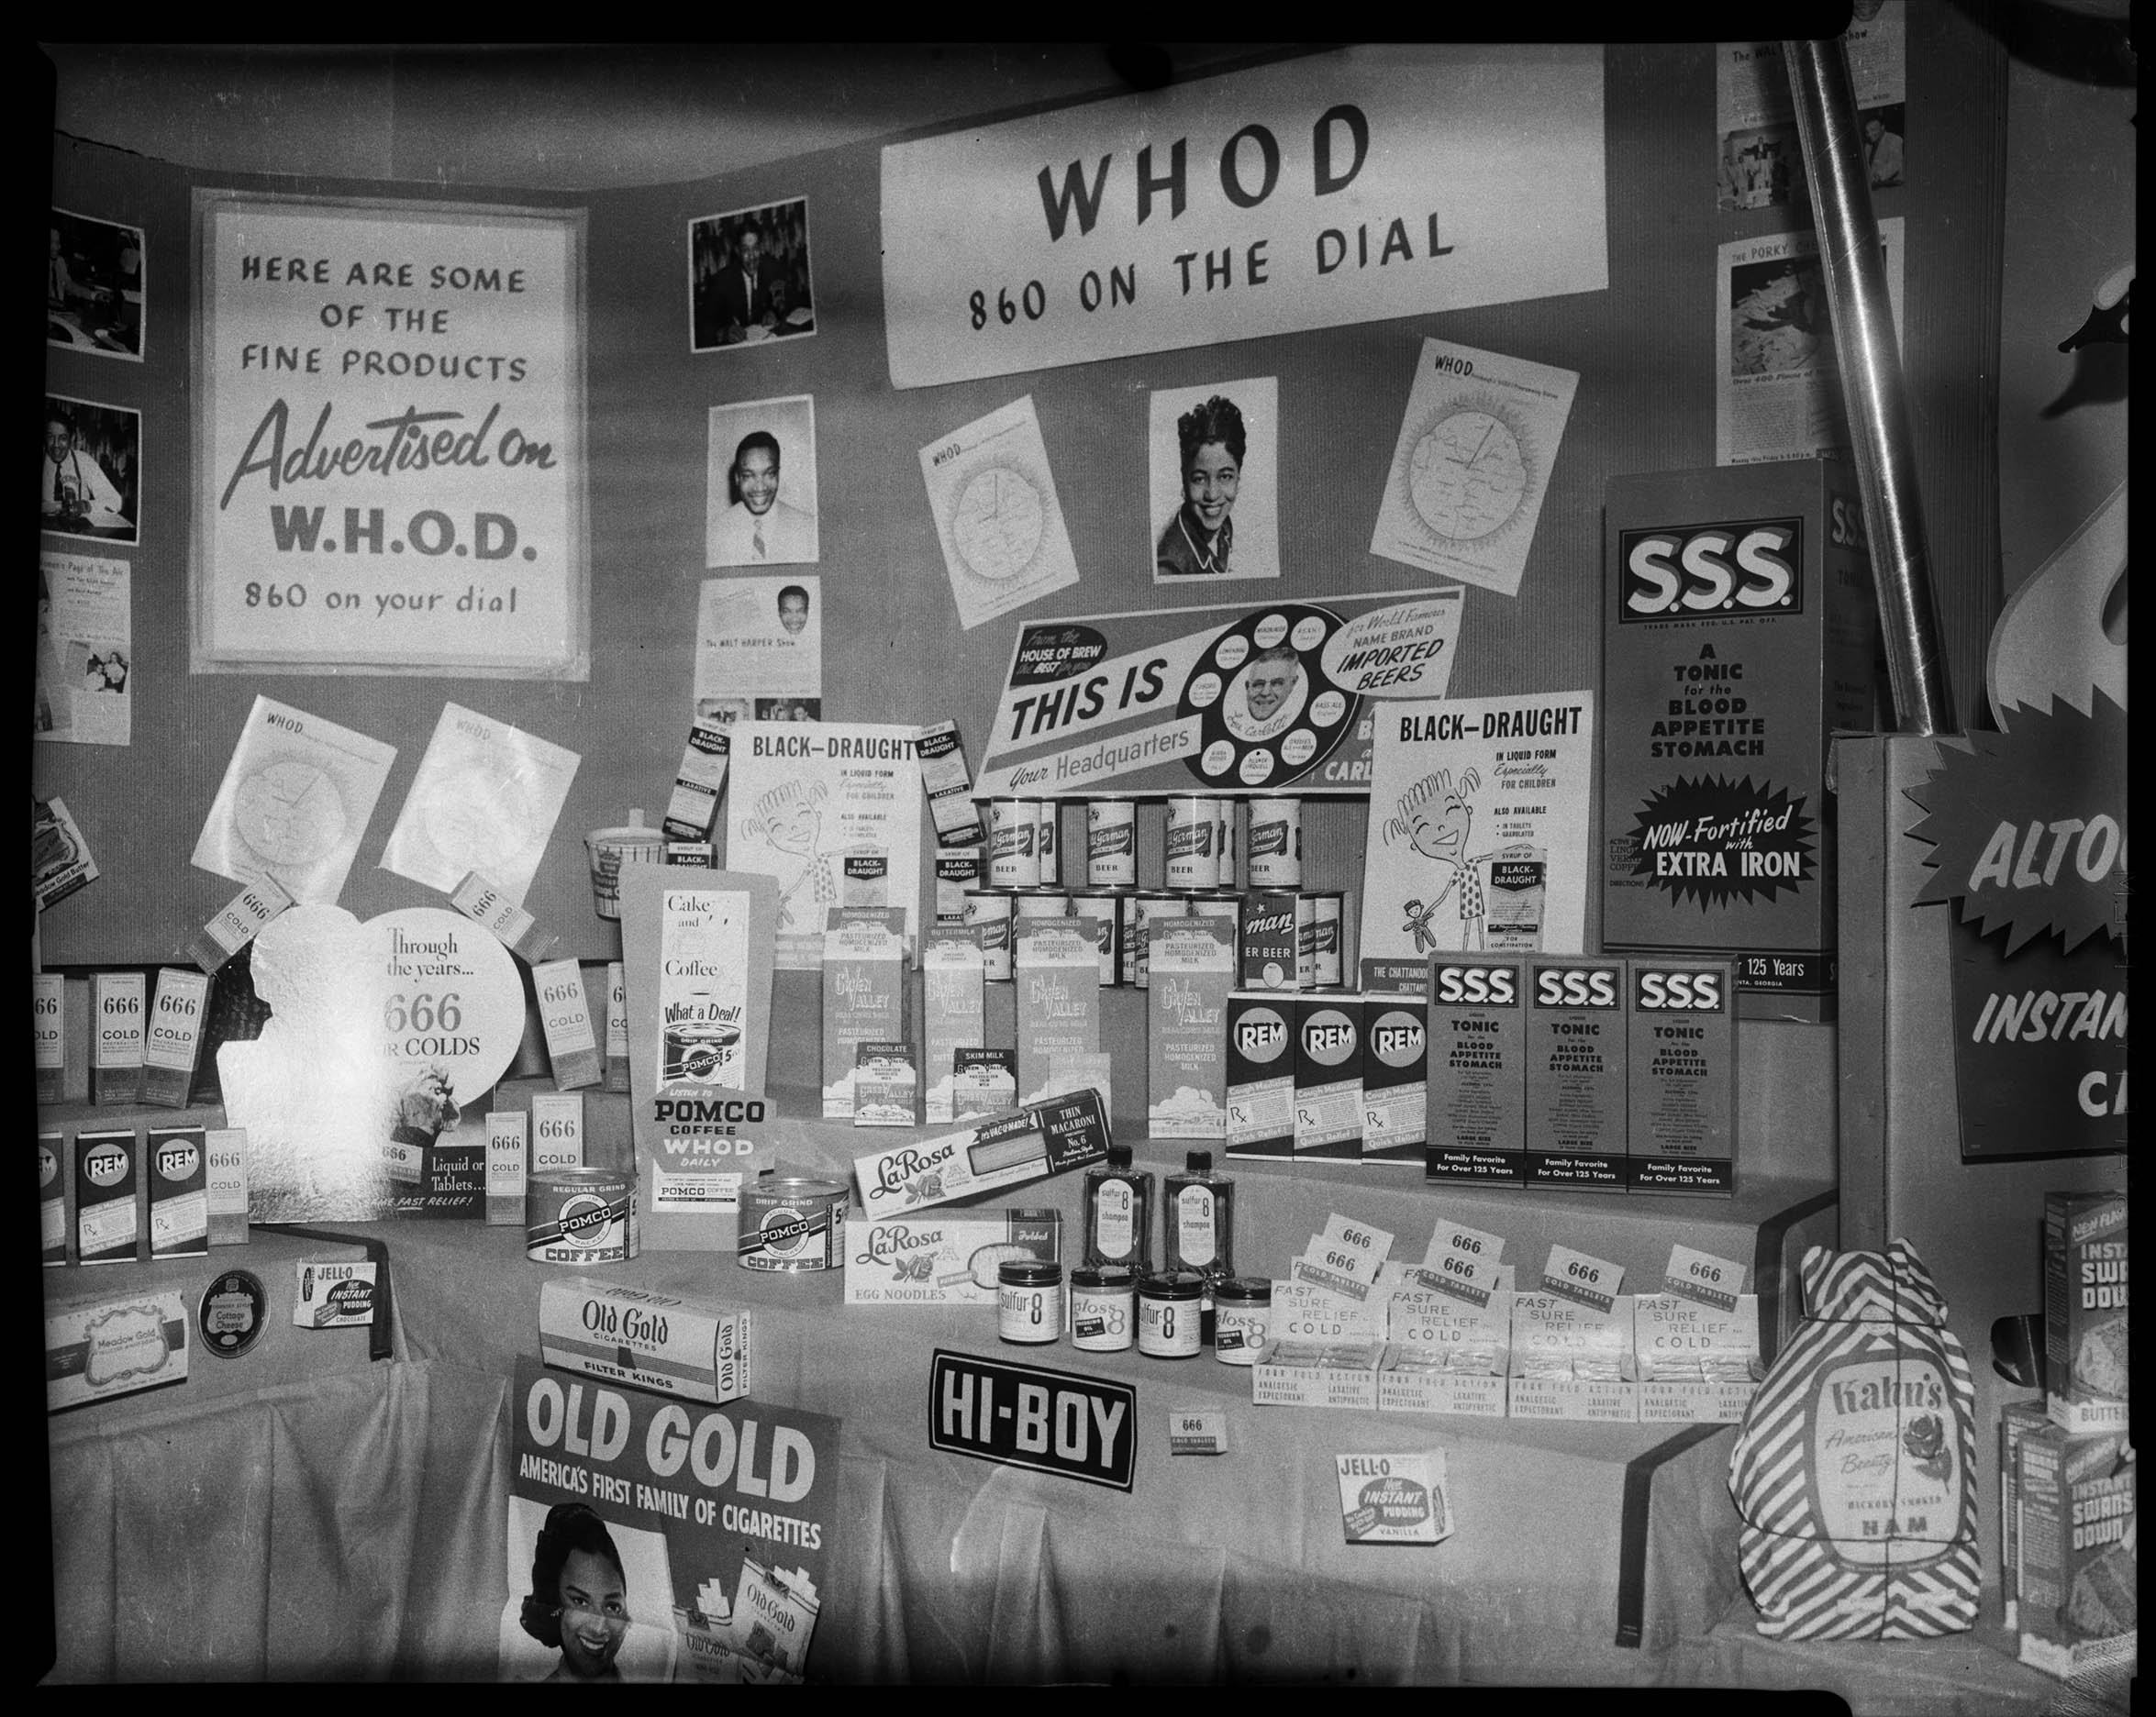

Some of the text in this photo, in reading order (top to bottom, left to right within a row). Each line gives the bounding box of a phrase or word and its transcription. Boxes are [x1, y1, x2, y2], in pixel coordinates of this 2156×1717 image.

[1038, 104, 1370, 242] WHOD
[242, 256, 525, 294] HERE ARE SOME
[969, 211, 1455, 330] 860 ON THE DIAL
[320, 304, 448, 334] OF THE
[242, 345, 527, 382] FINE PRODUCTS
[1434, 355, 1473, 377] WHOD
[220, 398, 500, 510] Advertised
[931, 443, 962, 466] WHOD
[271, 505, 538, 561] W.H.O.D.
[245, 582, 517, 618] 860 on your dial
[1353, 625, 1434, 649] NAME BRAND
[1020, 645, 1101, 662] HOUSE OF BREW
[1337, 638, 1444, 674] IMPORTED
[1699, 644, 1716, 659] A
[1033, 661, 1061, 674] BEST
[1356, 663, 1426, 691] BEERS
[1673, 663, 1742, 681] TONIC
[1684, 684, 1731, 695] for the
[1011, 659, 1168, 741] THIS IS
[1668, 698, 1747, 715] BLOOD
[266, 713, 304, 734] WHOD
[1650, 718, 1764, 737] APPETITE
[1496, 749, 1557, 761] IN LIQUID FORM
[1651, 739, 1764, 758] STOMACH
[1010, 767, 1048, 792] Your
[1056, 730, 1189, 780] Headquarters
[1494, 763, 1549, 778] Especially
[1502, 779, 1556, 790] FOR CHILDREN
[1514, 806, 1547, 814] AVAILABLE
[1096, 826, 1129, 847] German
[1725, 836, 1754, 850] with
[1968, 814, 2128, 892] ALTO
[1095, 864, 1118, 872] BEER
[1502, 865, 1534, 874] BLACK-
[1656, 851, 1800, 877] EXTRA IRON
[1495, 874, 1537, 885] DRAUGHT
[668, 895, 710, 912] Cake
[678, 916, 699, 927] and
[387, 927, 458, 960] Through
[387, 955, 412, 976] the
[665, 959, 717, 977] Coffee
[1748, 958, 1805, 977] 125 Years
[104, 998, 139, 1014] 666
[383, 992, 461, 1033] 666
[664, 1003, 741, 1024] What a Deal!
[102, 1029, 139, 1040] COLD
[1451, 1021, 1499, 1033] TONIC
[406, 1037, 481, 1056] COLDS
[1241, 1025, 1283, 1050] REM
[1297, 1082, 1359, 1098] Cough Medicine
[654, 1100, 765, 1123] POMCO
[1060, 1106, 1082, 1119] THIN
[670, 1125, 736, 1135] COFFEE
[1050, 1116, 1096, 1135] MACARONI
[663, 1138, 754, 1156] WHOD
[1067, 1135, 1087, 1147] No. 6
[159, 1149, 196, 1173] REM
[432, 1157, 484, 1173] Liquid or
[680, 1157, 721, 1168] DAILY
[1444, 1154, 1506, 1164] Family Favorite
[1490, 1167, 1513, 1175] Years
[553, 1185, 595, 1193] REGULAR
[428, 1196, 473, 1206] RELIEF!
[560, 1208, 612, 1232] POMCO
[1343, 1228, 1372, 1249] 666
[545, 1246, 623, 1262] COFFEE
[1568, 1262, 1600, 1283] 666
[855, 1290, 947, 1301] EGG NOODLES
[1638, 1300, 1681, 1310] FAST
[216, 1311, 245, 1322] Cottage
[216, 1321, 244, 1330] Cheese
[583, 1300, 669, 1345] Old Gold
[1653, 1313, 1697, 1322] SURE
[97, 1328, 157, 1349] Meadow Gold
[594, 1332, 657, 1351] CIGARETTES
[1655, 1336, 1711, 1348] COLD
[584, 1362, 673, 1389] FILTER KINGS
[943, 1369, 1126, 1468] HI-BOY
[1183, 1419, 1202, 1432] 666
[527, 1378, 815, 1502] OLD GOLD
[520, 1454, 821, 1549] AMERICA'S FIRST FAMILY OF CIGARETTES
[1364, 1490, 1423, 1505] INSTANT
[1383, 1506, 1426, 1518] PUDDING
[2073, 1491, 2133, 1525] SWANS
[1862, 1516, 1928, 1536] HAM
